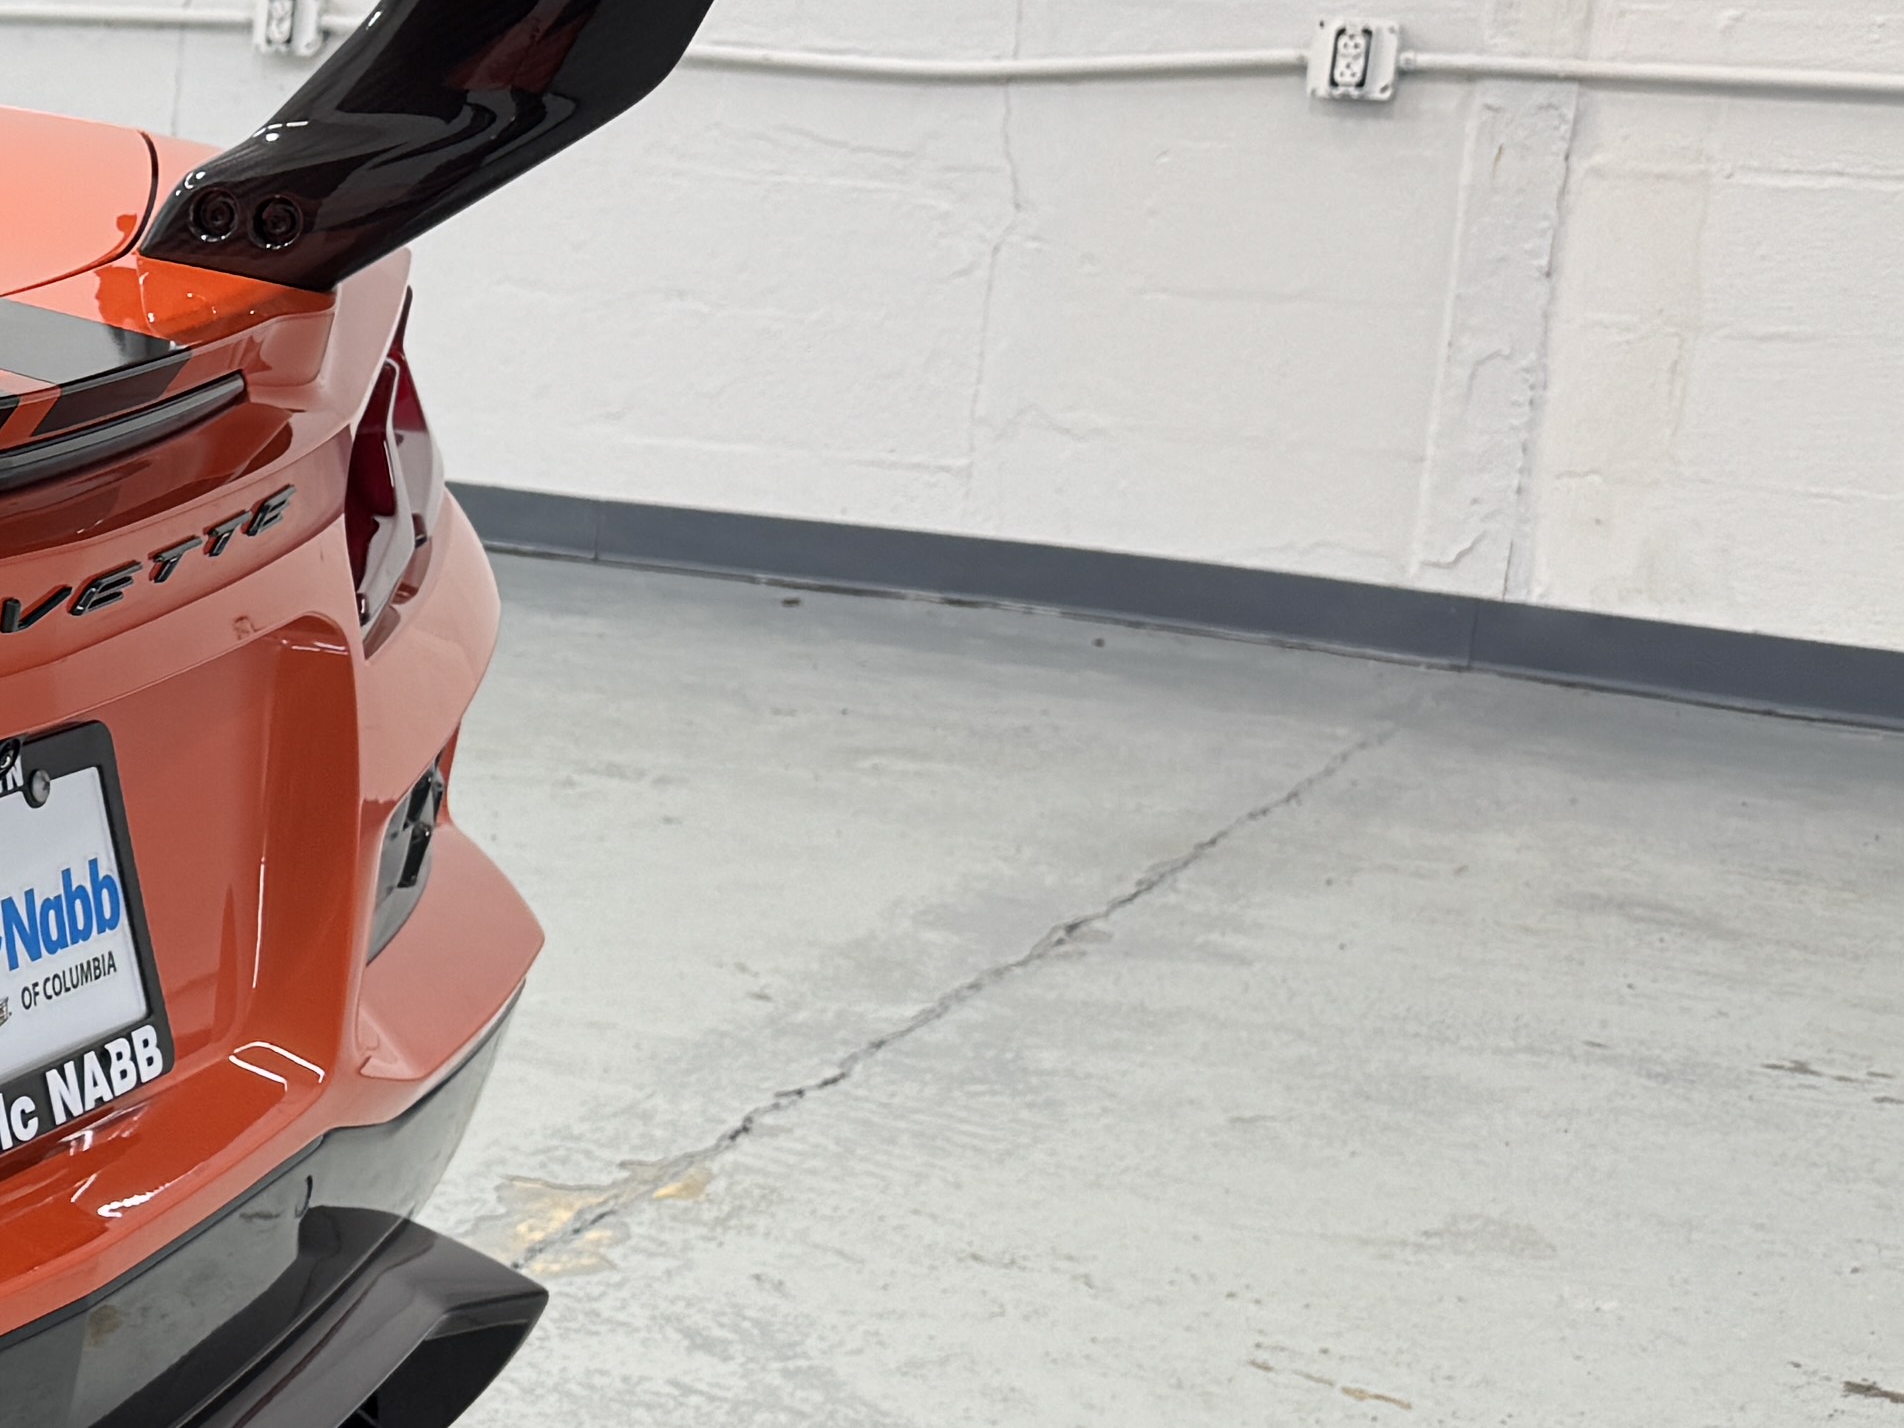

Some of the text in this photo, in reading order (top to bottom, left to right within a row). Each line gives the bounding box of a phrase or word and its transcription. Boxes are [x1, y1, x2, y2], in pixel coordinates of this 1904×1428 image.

[21, 950, 118, 1010] OF COLUMBIA
[45, 1024, 163, 1125] NABB
